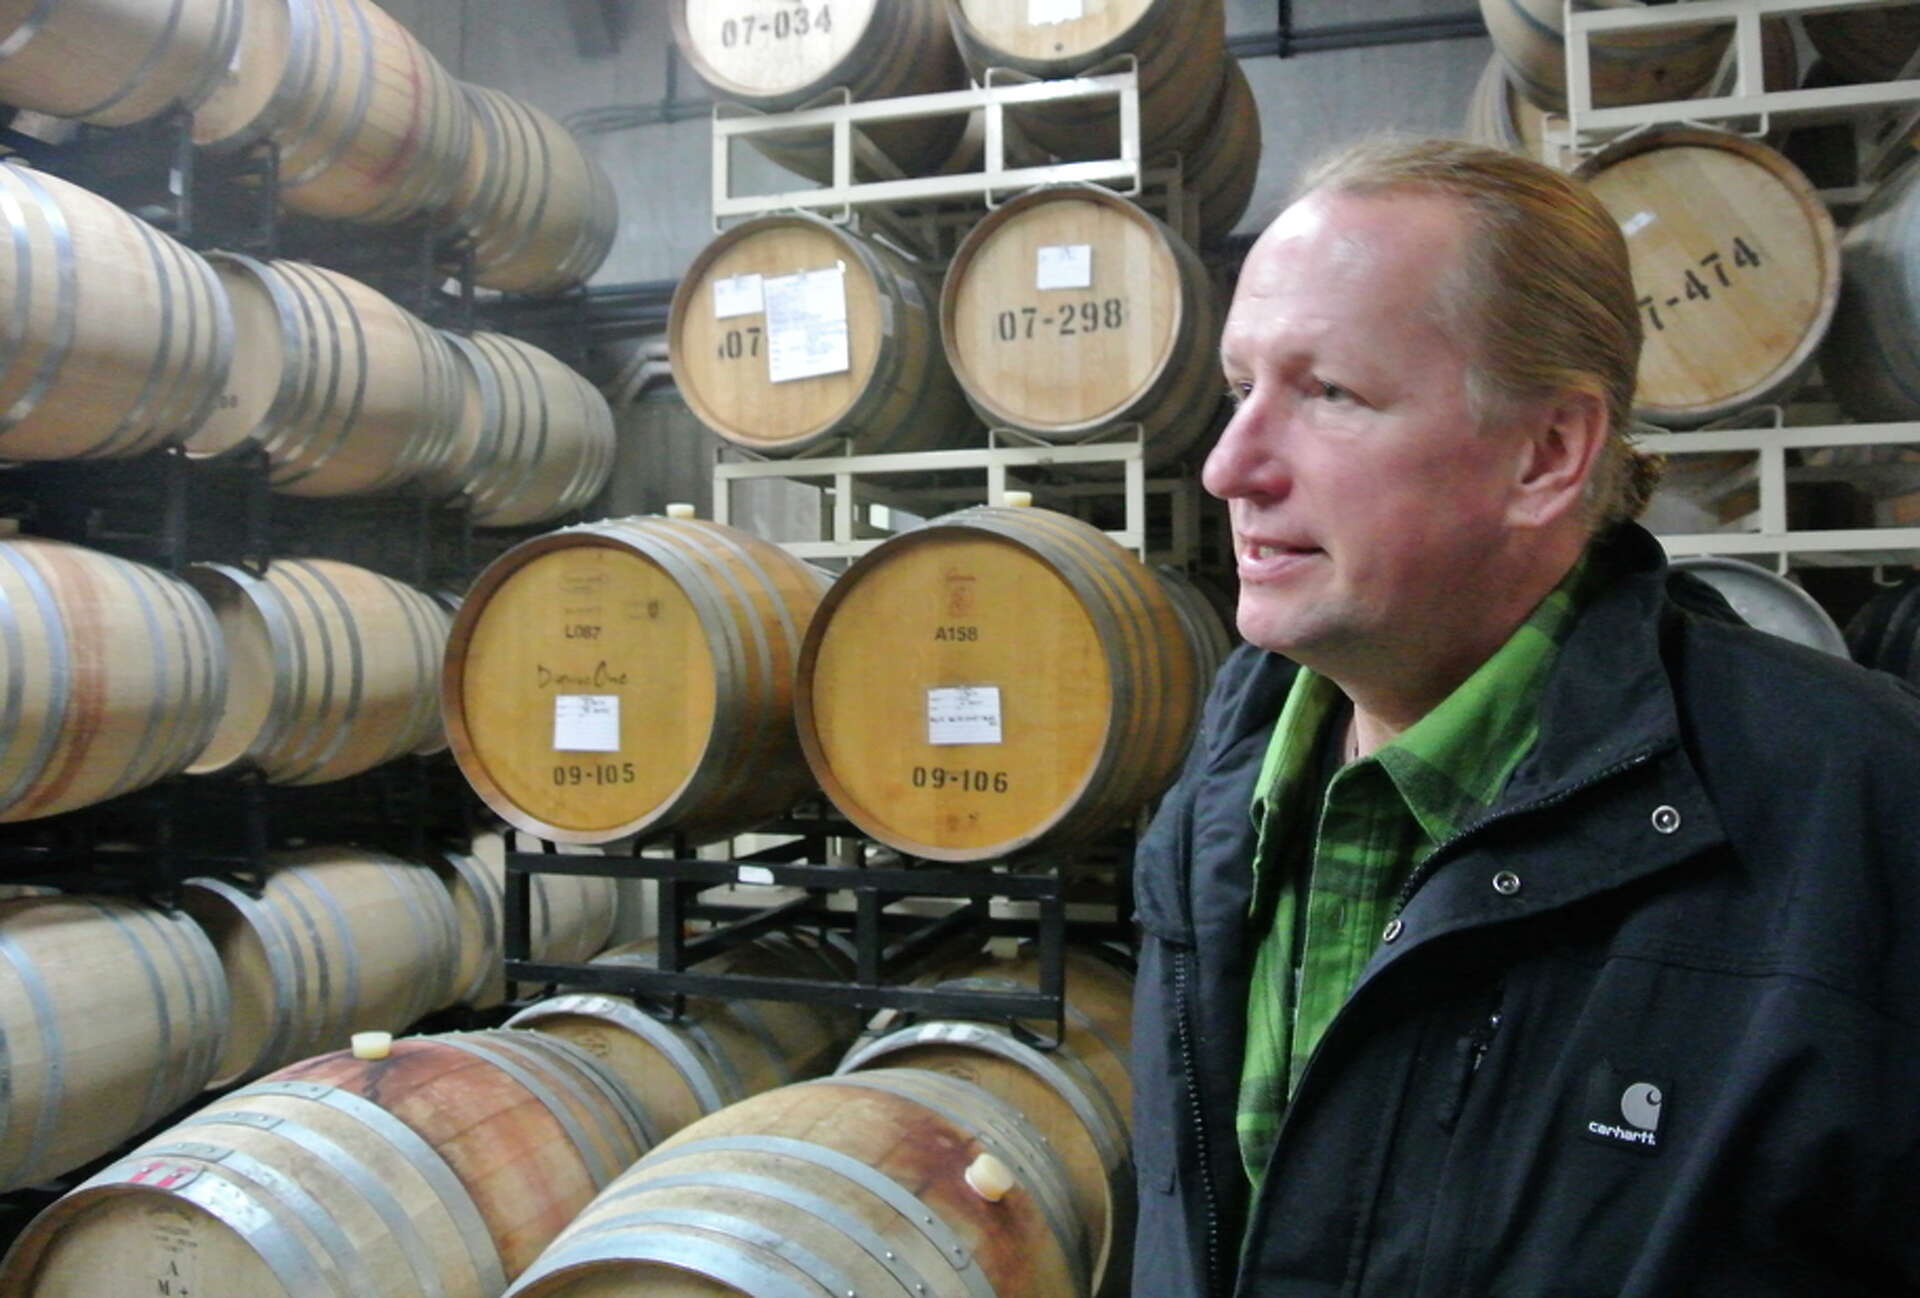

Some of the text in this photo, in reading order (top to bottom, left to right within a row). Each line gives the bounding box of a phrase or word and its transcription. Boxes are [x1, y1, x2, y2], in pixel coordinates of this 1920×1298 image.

[721, 4, 832, 48] 07-034
[998, 297, 1123, 341] 07-298
[935, 625, 979, 641] A158
[553, 762, 636, 786] 09-105
[912, 766, 1009, 794] 09-106
[1588, 1121, 1656, 1146] carhartt
